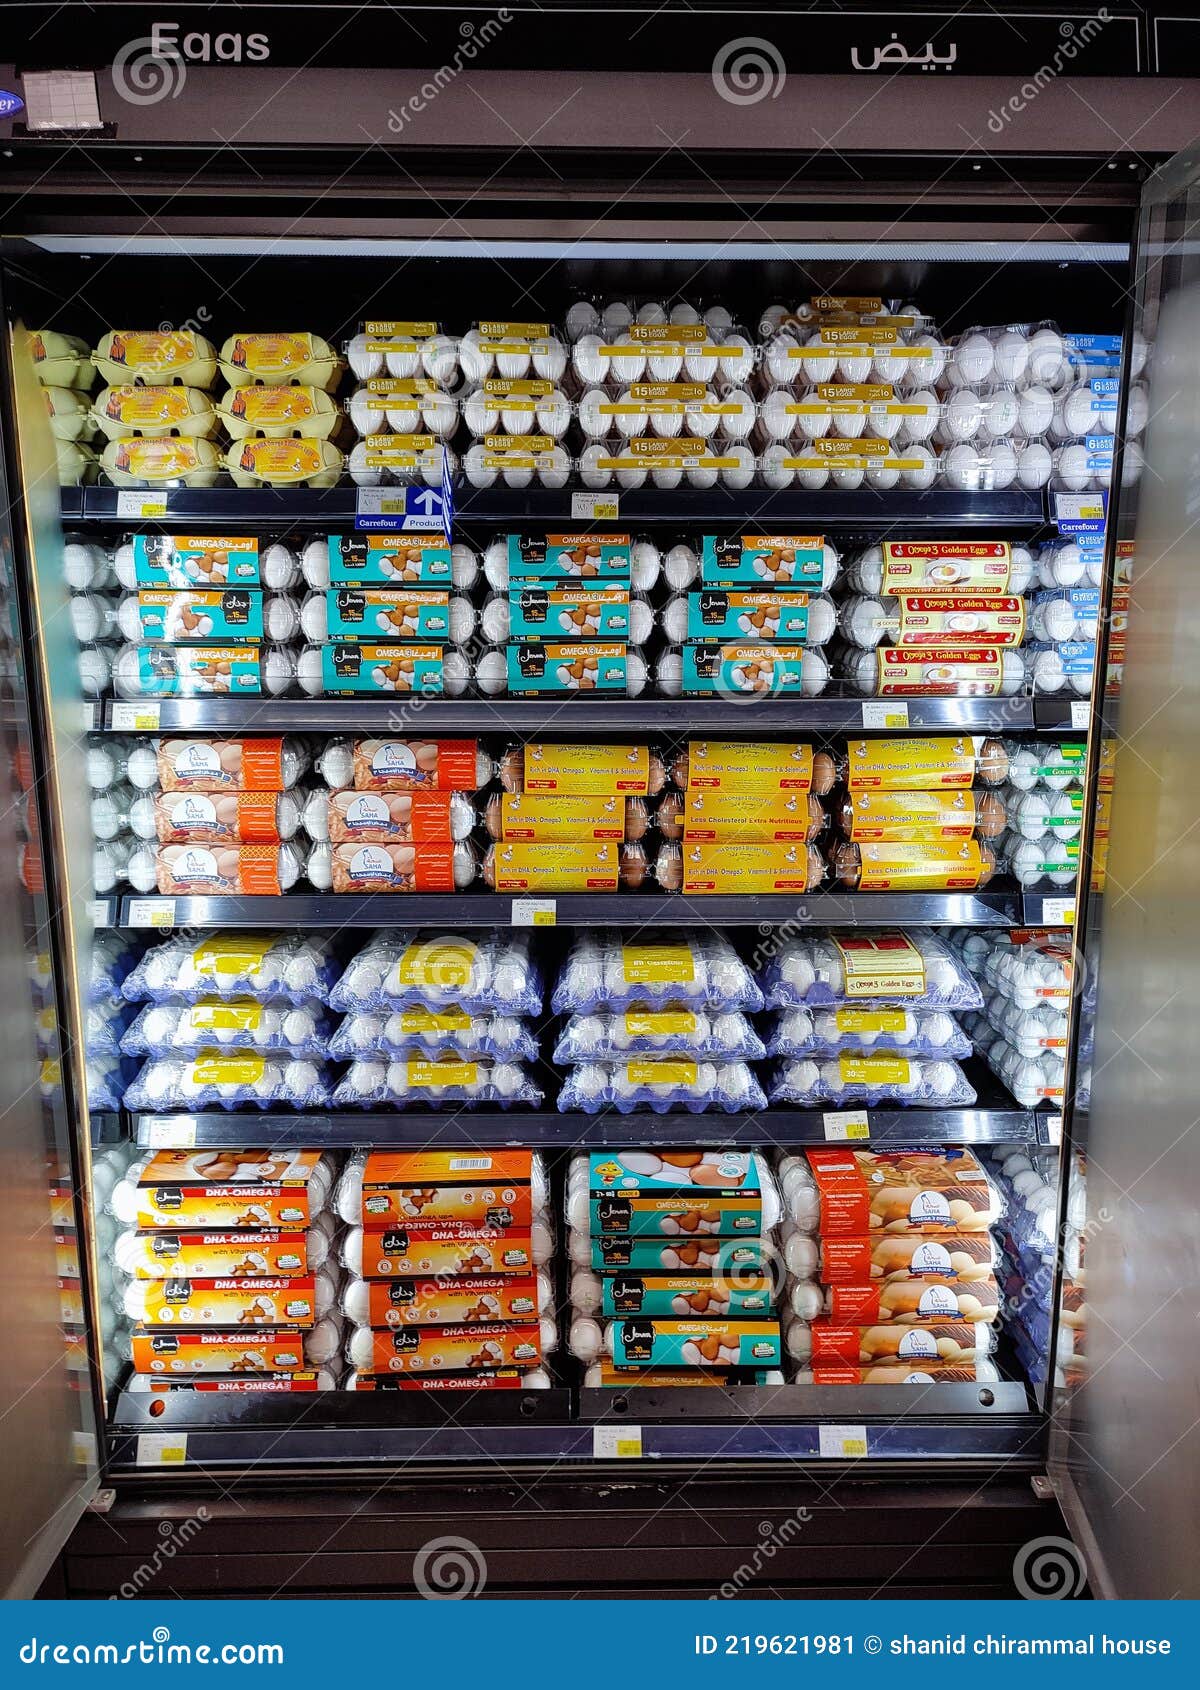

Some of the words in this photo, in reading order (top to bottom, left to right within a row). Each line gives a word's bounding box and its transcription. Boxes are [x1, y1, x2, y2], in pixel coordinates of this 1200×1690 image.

[851, 33, 957, 71] بيض
[368, 324, 375, 333] 6
[480, 324, 488, 333] 6
[634, 328, 648, 338] 15
[824, 331, 838, 340] 15
[369, 381, 377, 390] 6
[486, 382, 494, 391] 6
[1094, 382, 1100, 391] 6
[634, 387, 648, 396] 15
[822, 388, 835, 397] 15
[368, 438, 375, 448] 6
[486, 438, 494, 448] 6
[634, 442, 648, 451] 15
[818, 442, 833, 452] 15
[1089, 440, 1095, 449] 6
[1061, 523, 1099, 531] Carrefour
[1079, 536, 1085, 545] 6
[941, 546, 968, 554] Golden
[970, 546, 988, 555] Eggs
[1072, 593, 1078, 602] 6
[958, 600, 983, 608] Golden
[986, 600, 1003, 609] Eggs
[964, 652, 981, 661] Eggs
[902, 980, 915, 988] Eggs
